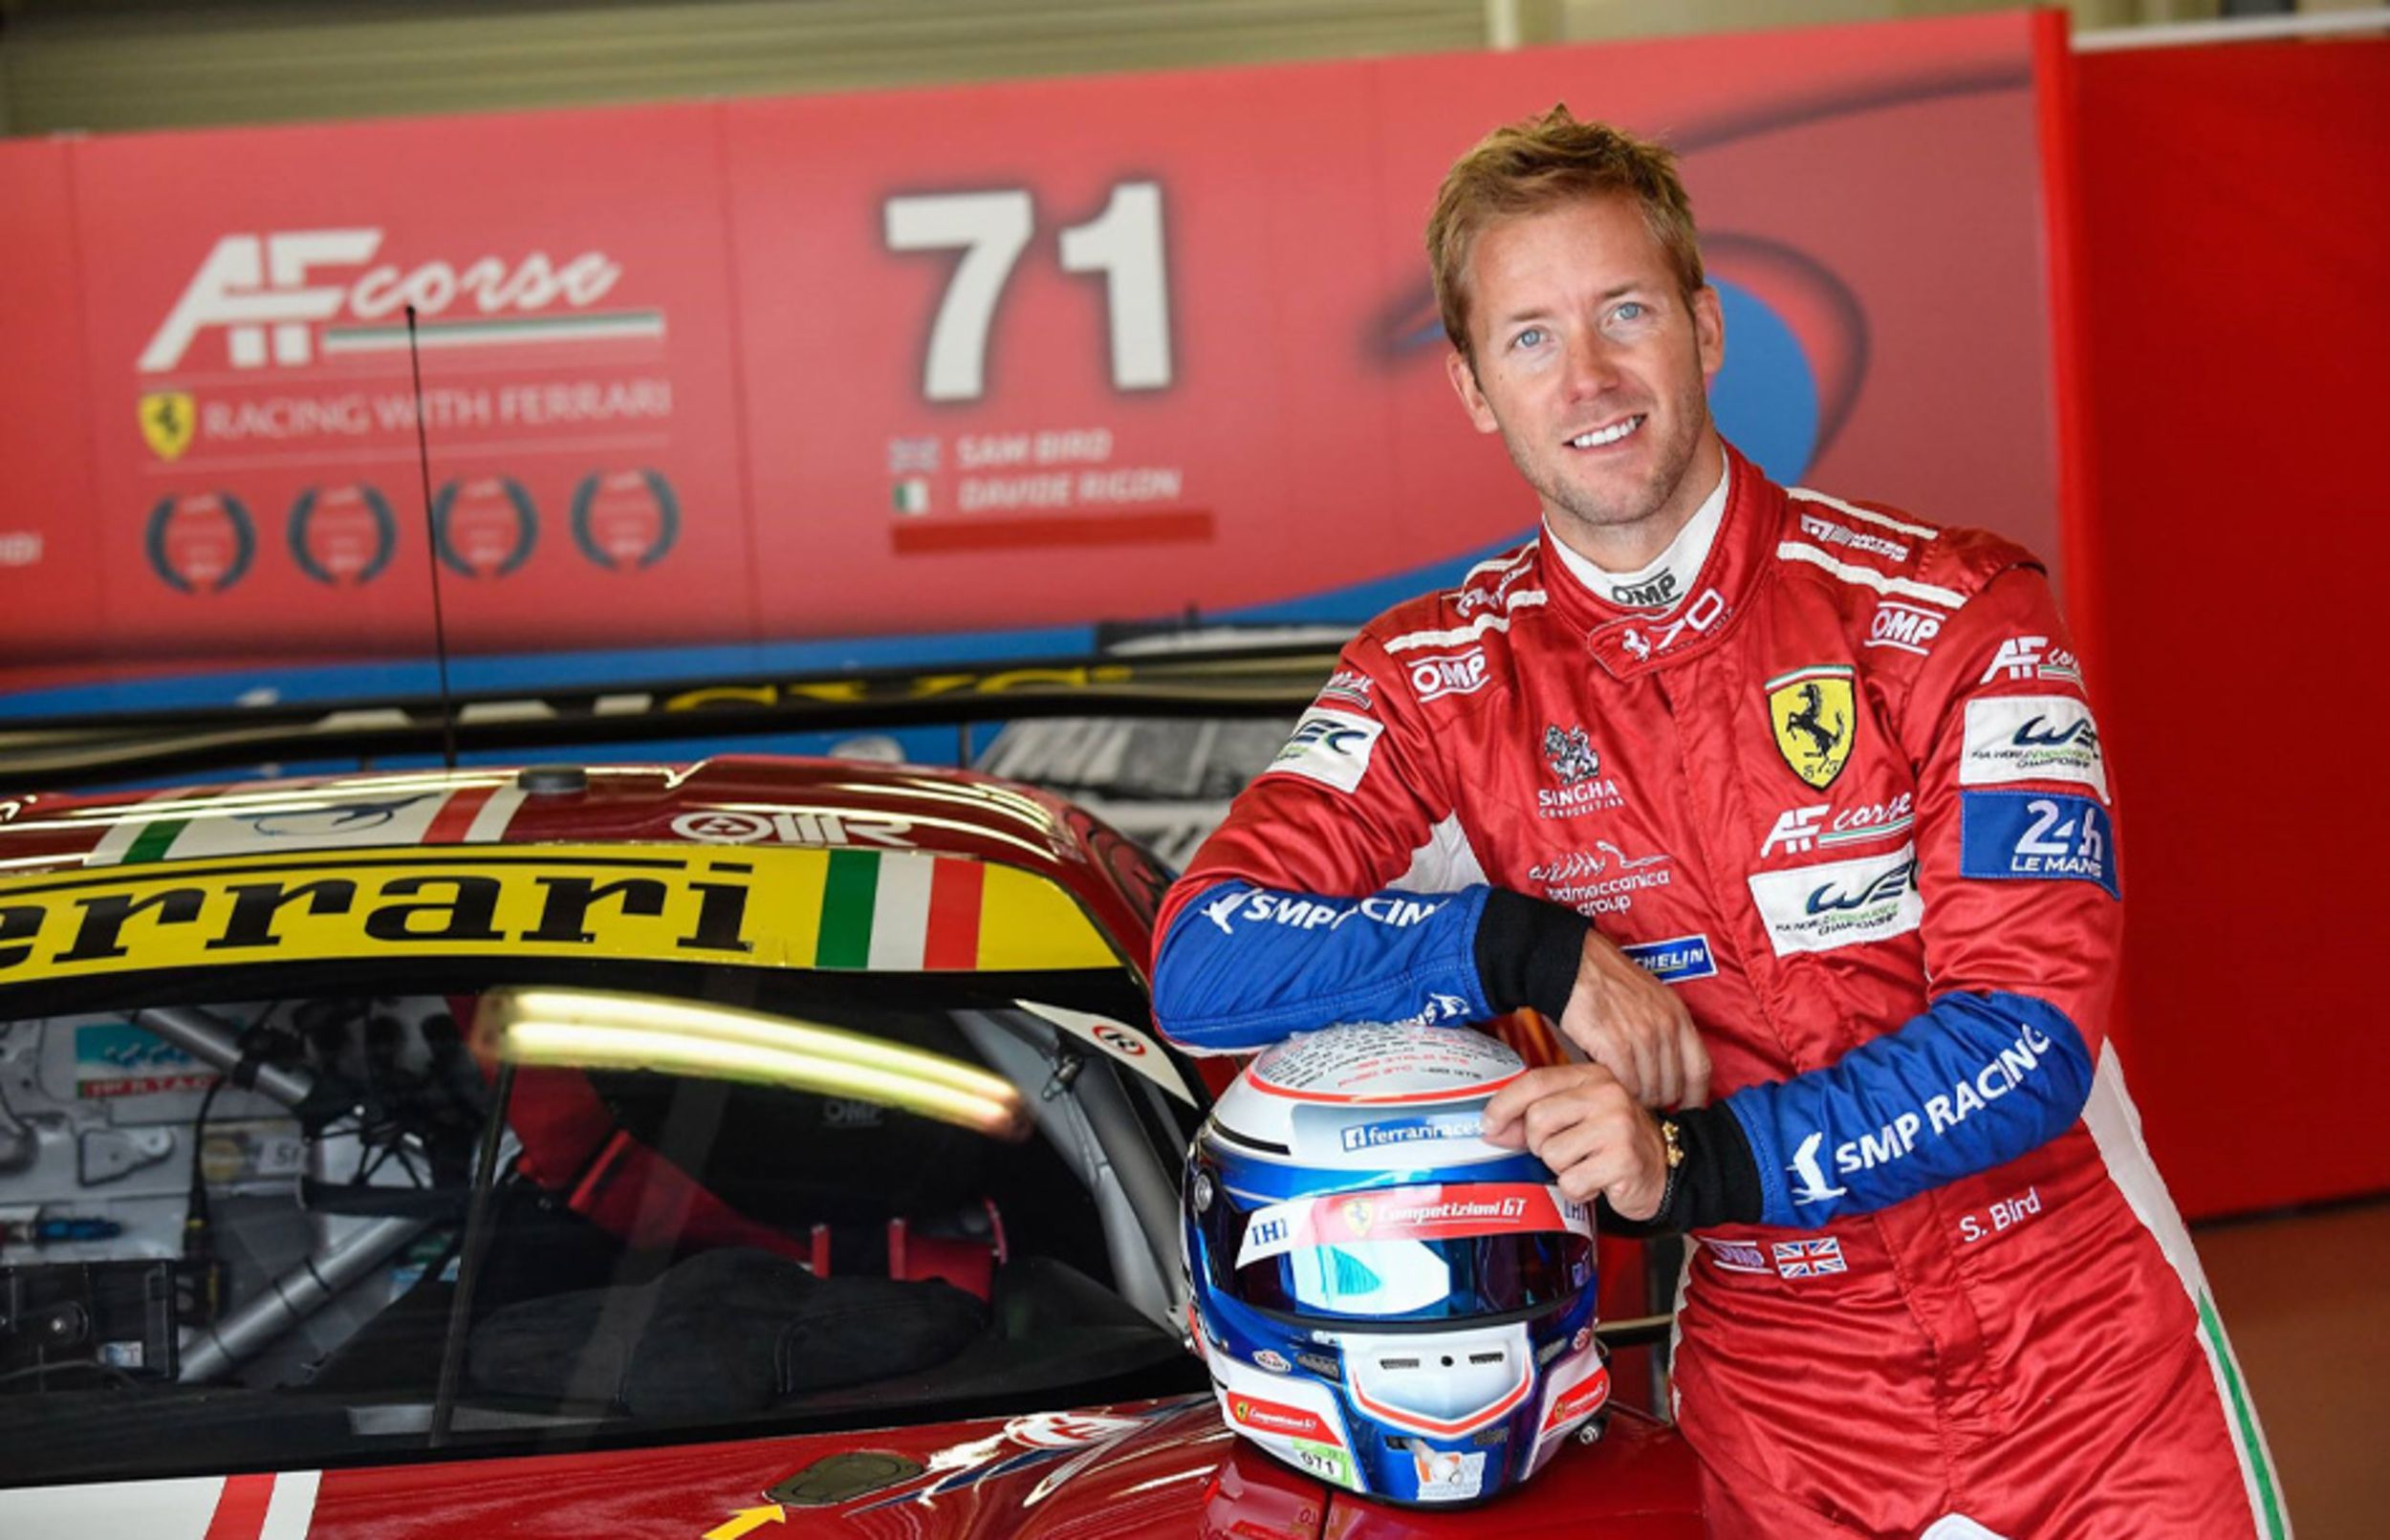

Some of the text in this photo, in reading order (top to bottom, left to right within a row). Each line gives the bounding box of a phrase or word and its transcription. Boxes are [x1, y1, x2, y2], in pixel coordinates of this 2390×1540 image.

[884, 182, 1172, 401] 71
[204, 380, 673, 440] RACING WITH FERRARI
[957, 429, 1113, 469] SAM BIRD
[959, 467, 1183, 510] DAVIDE RIGON
[1612, 573, 1677, 605] OMP
[1871, 609, 1941, 646] OMP
[1412, 653, 1487, 695] OMP
[1979, 636, 2049, 684] AF
[1538, 779, 1619, 807] SINGHA
[1760, 804, 1831, 858] AF
[2010, 856, 2103, 878] LE MANS
[1243, 896, 1337, 931] SMP
[1835, 1022, 2053, 1176] SMP RACING
[1960, 1187, 2043, 1243] S. Bird
